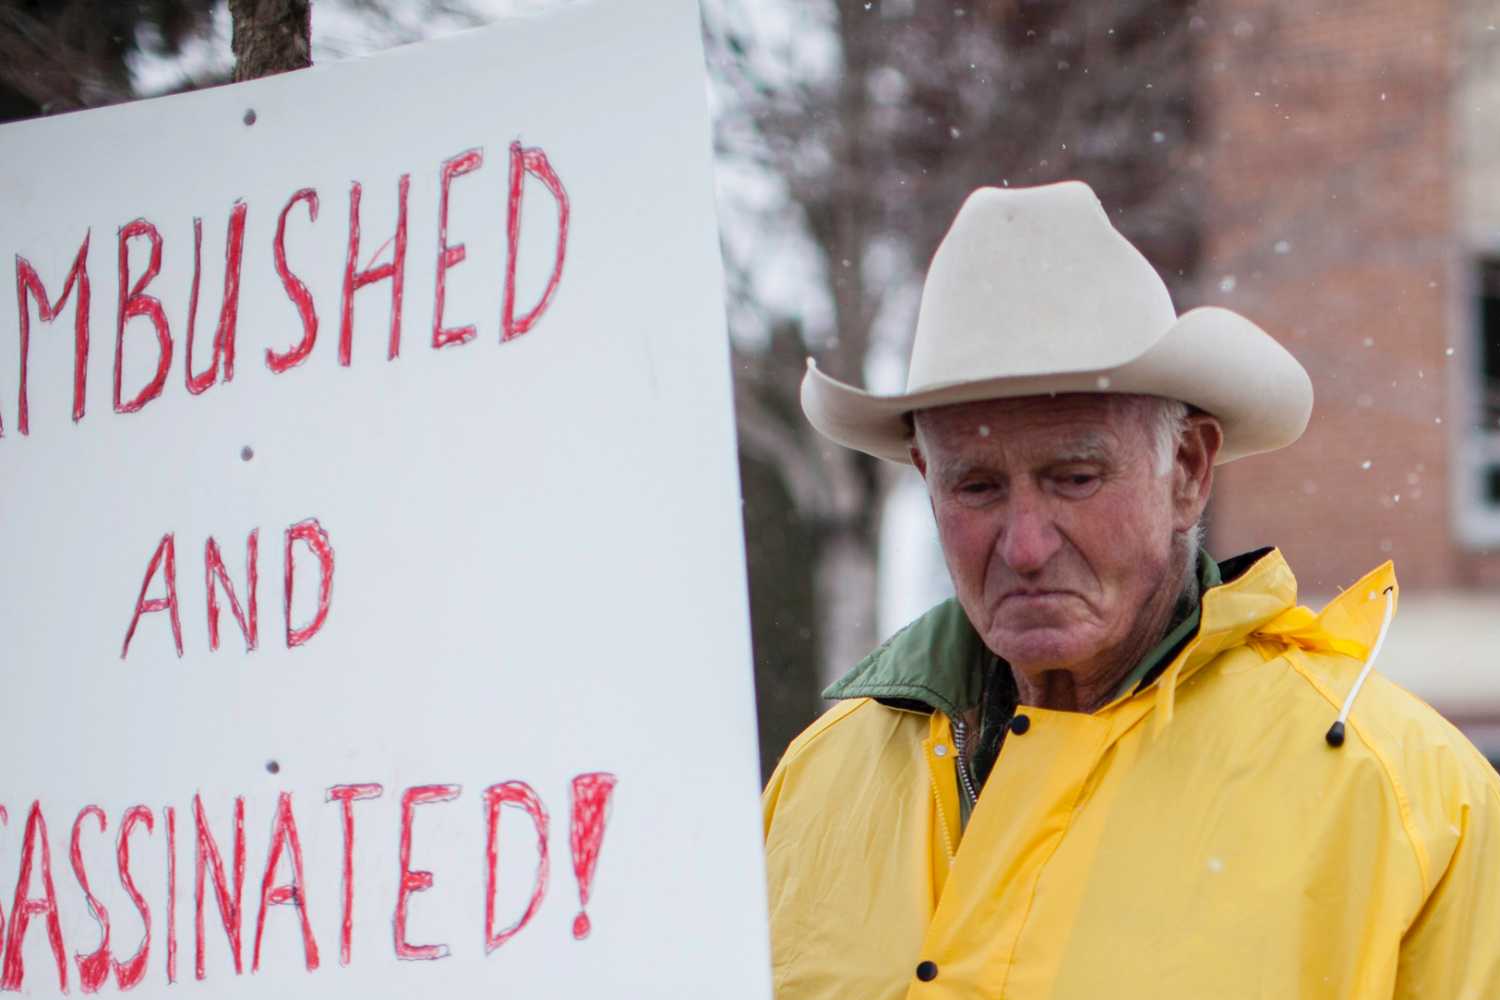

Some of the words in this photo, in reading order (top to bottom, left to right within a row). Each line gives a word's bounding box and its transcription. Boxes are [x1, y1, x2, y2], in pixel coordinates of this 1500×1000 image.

[0, 134, 571, 438] MBUSHED
[119, 515, 336, 661] AND
[0, 770, 618, 995] ASSINATED!
